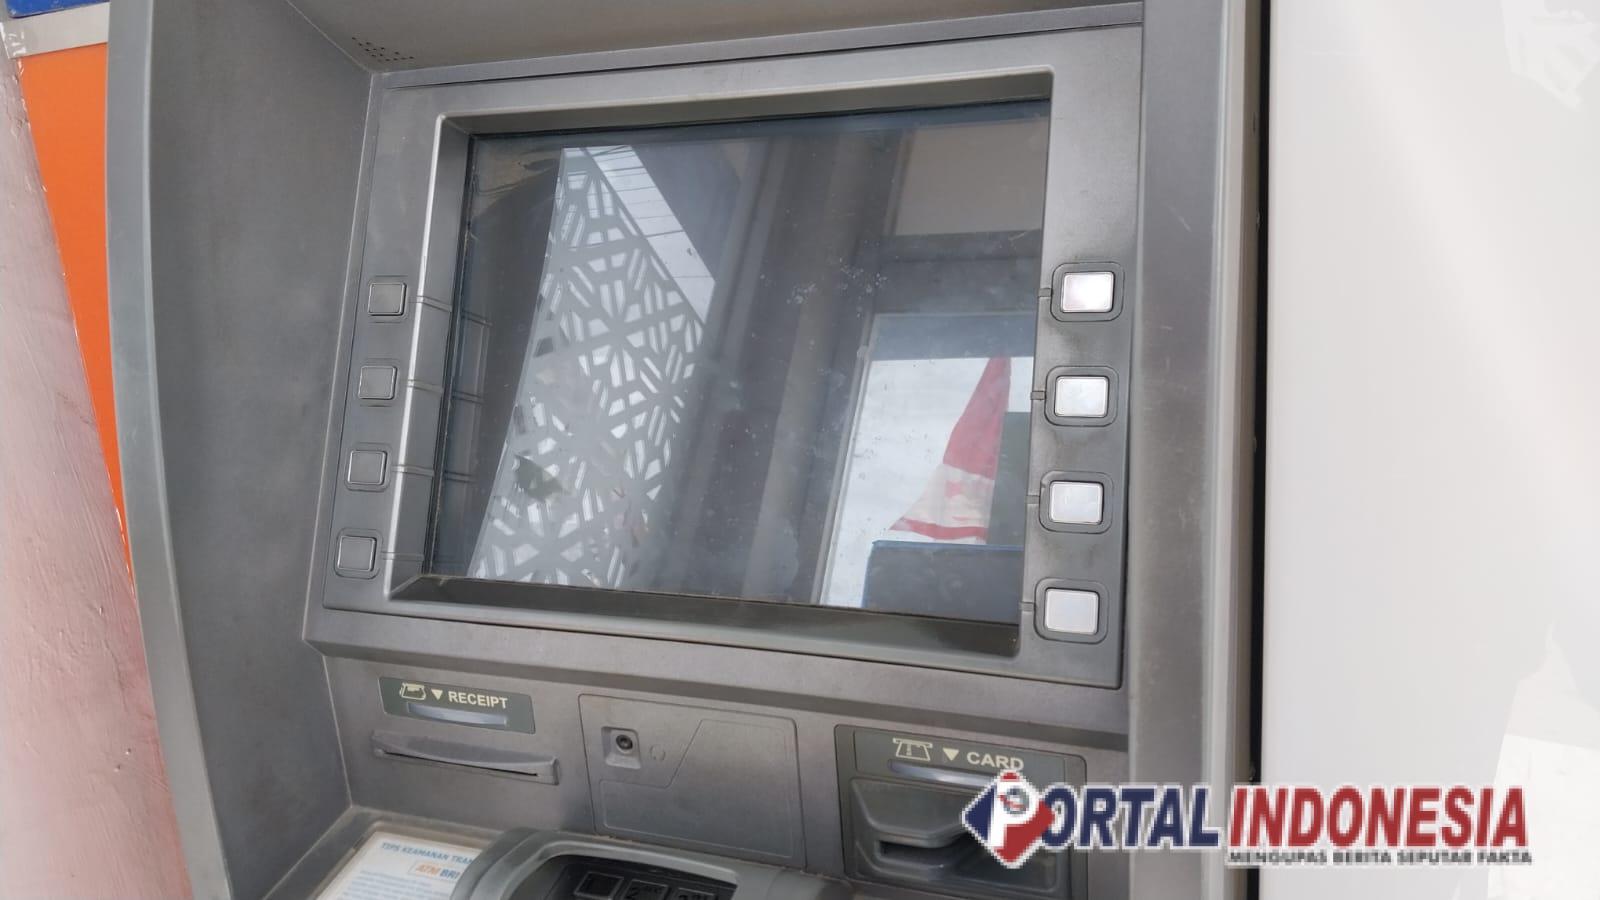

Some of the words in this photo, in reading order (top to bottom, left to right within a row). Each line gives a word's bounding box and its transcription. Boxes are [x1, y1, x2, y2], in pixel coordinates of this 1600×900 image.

[448, 690, 508, 709] RECEIPT
[966, 751, 1025, 771] CARD
[381, 841, 400, 852] TIPS
[401, 847, 449, 861] KEAMANAN
[416, 864, 440, 876] ATM
[439, 869, 461, 880] BRI
